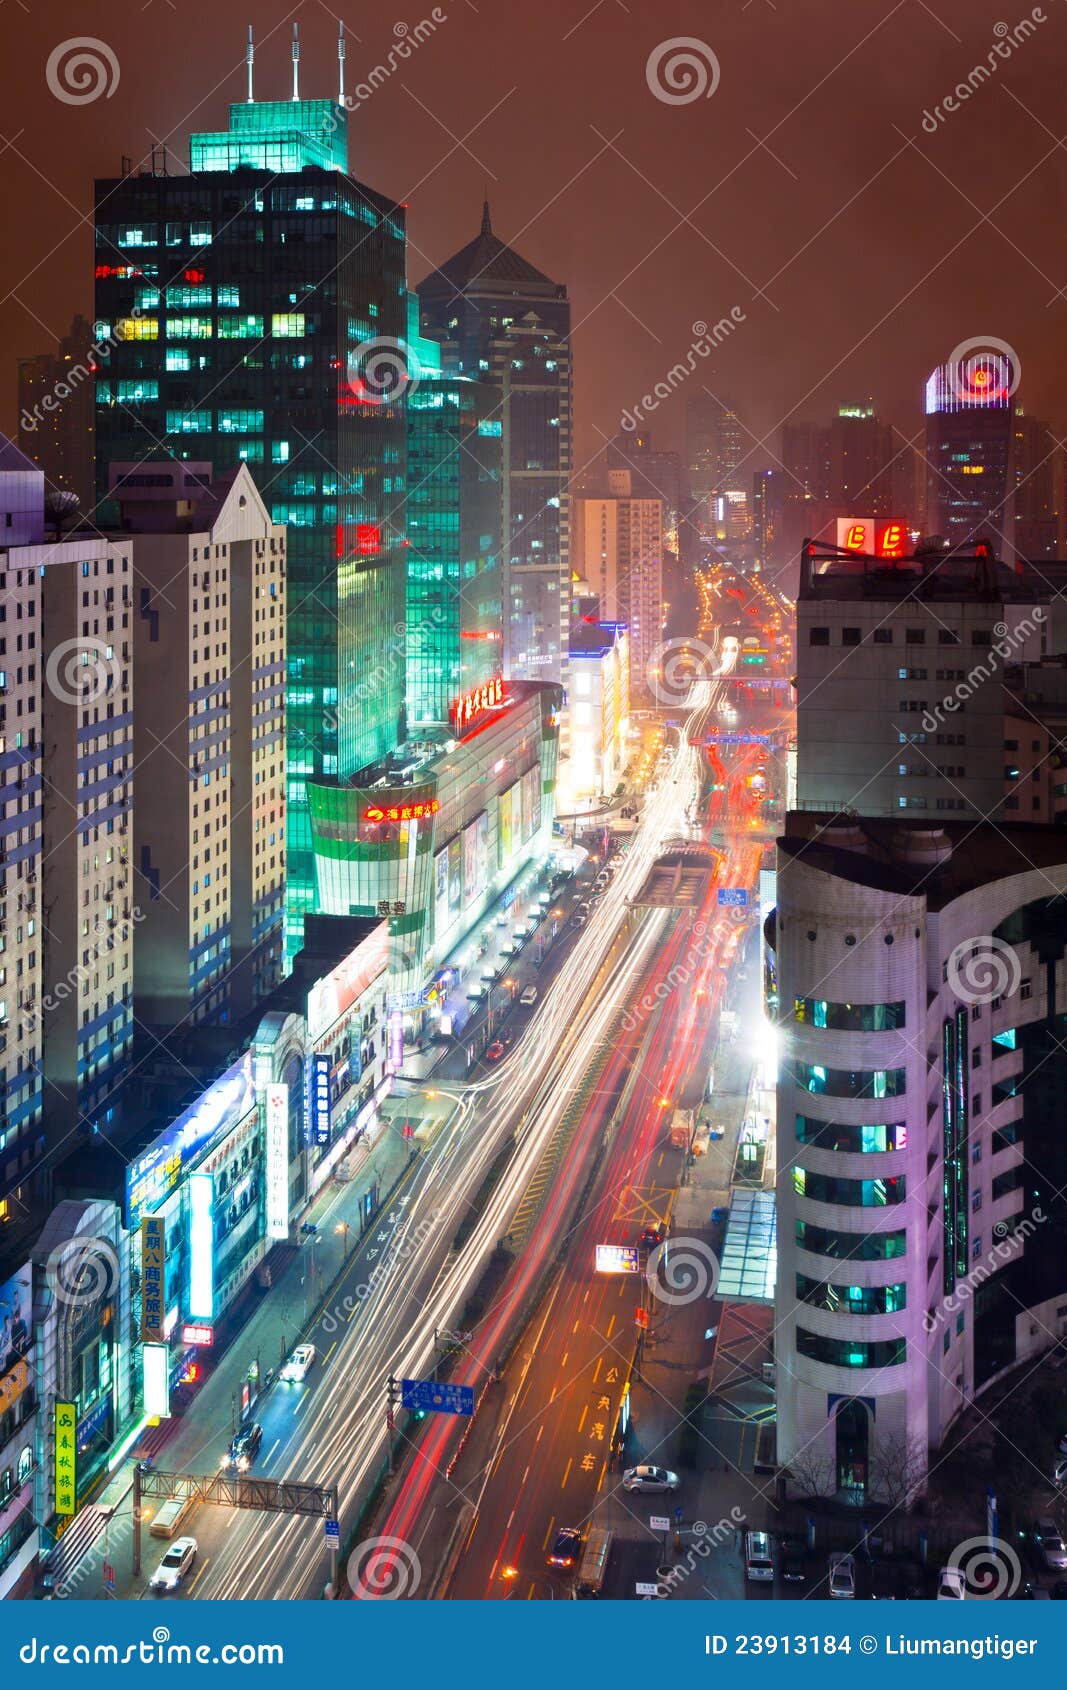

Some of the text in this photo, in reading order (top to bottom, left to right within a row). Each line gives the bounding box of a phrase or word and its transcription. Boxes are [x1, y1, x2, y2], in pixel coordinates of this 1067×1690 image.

[145, 1220, 161, 1329] 星期八商务旅店
[59, 1435, 73, 1507] 春秋旅游
